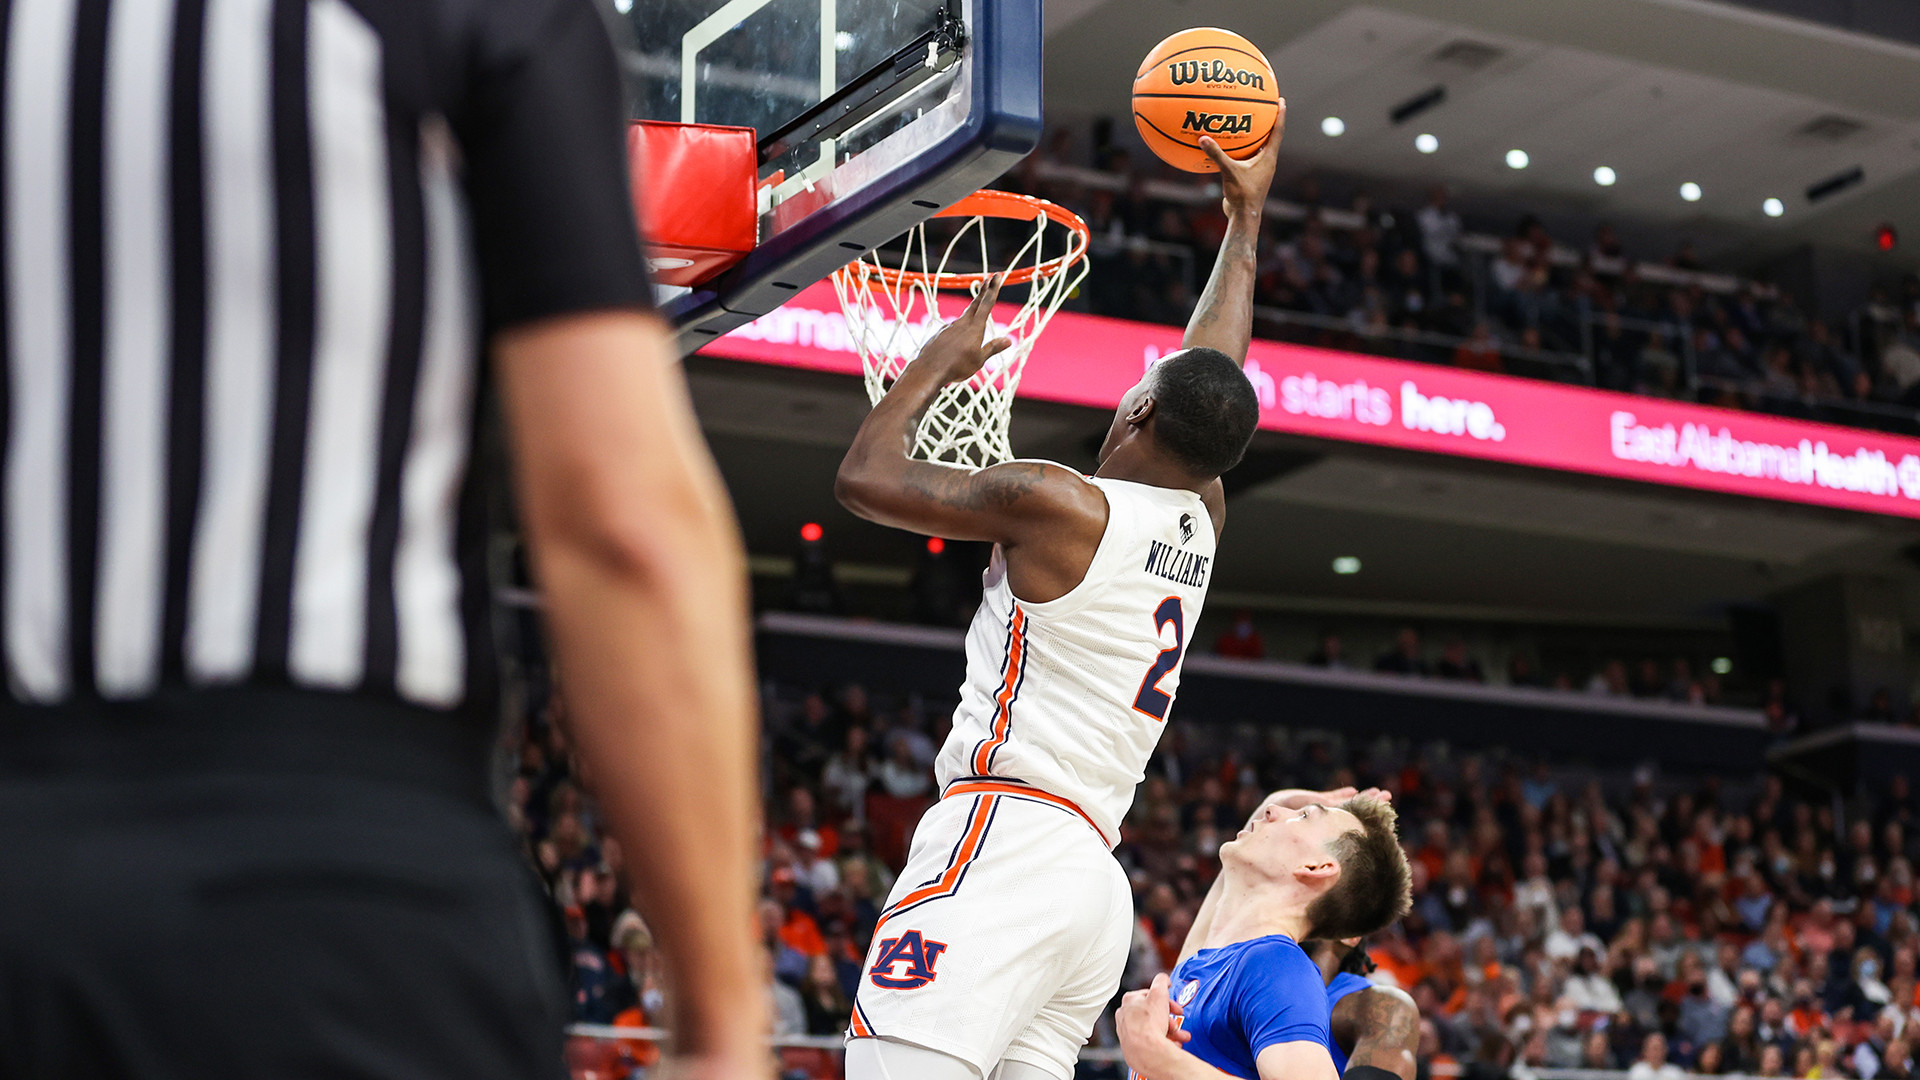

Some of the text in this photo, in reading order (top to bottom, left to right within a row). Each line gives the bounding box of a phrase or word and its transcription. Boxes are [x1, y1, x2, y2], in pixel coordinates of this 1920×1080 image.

[1169, 59, 1265, 92] Wilson
[1181, 110, 1252, 134] NCAA
[1281, 372, 1392, 426] starts
[1401, 380, 1506, 442] here.
[1145, 539, 1209, 588] WILLIAMS
[1132, 595, 1184, 722] 2
